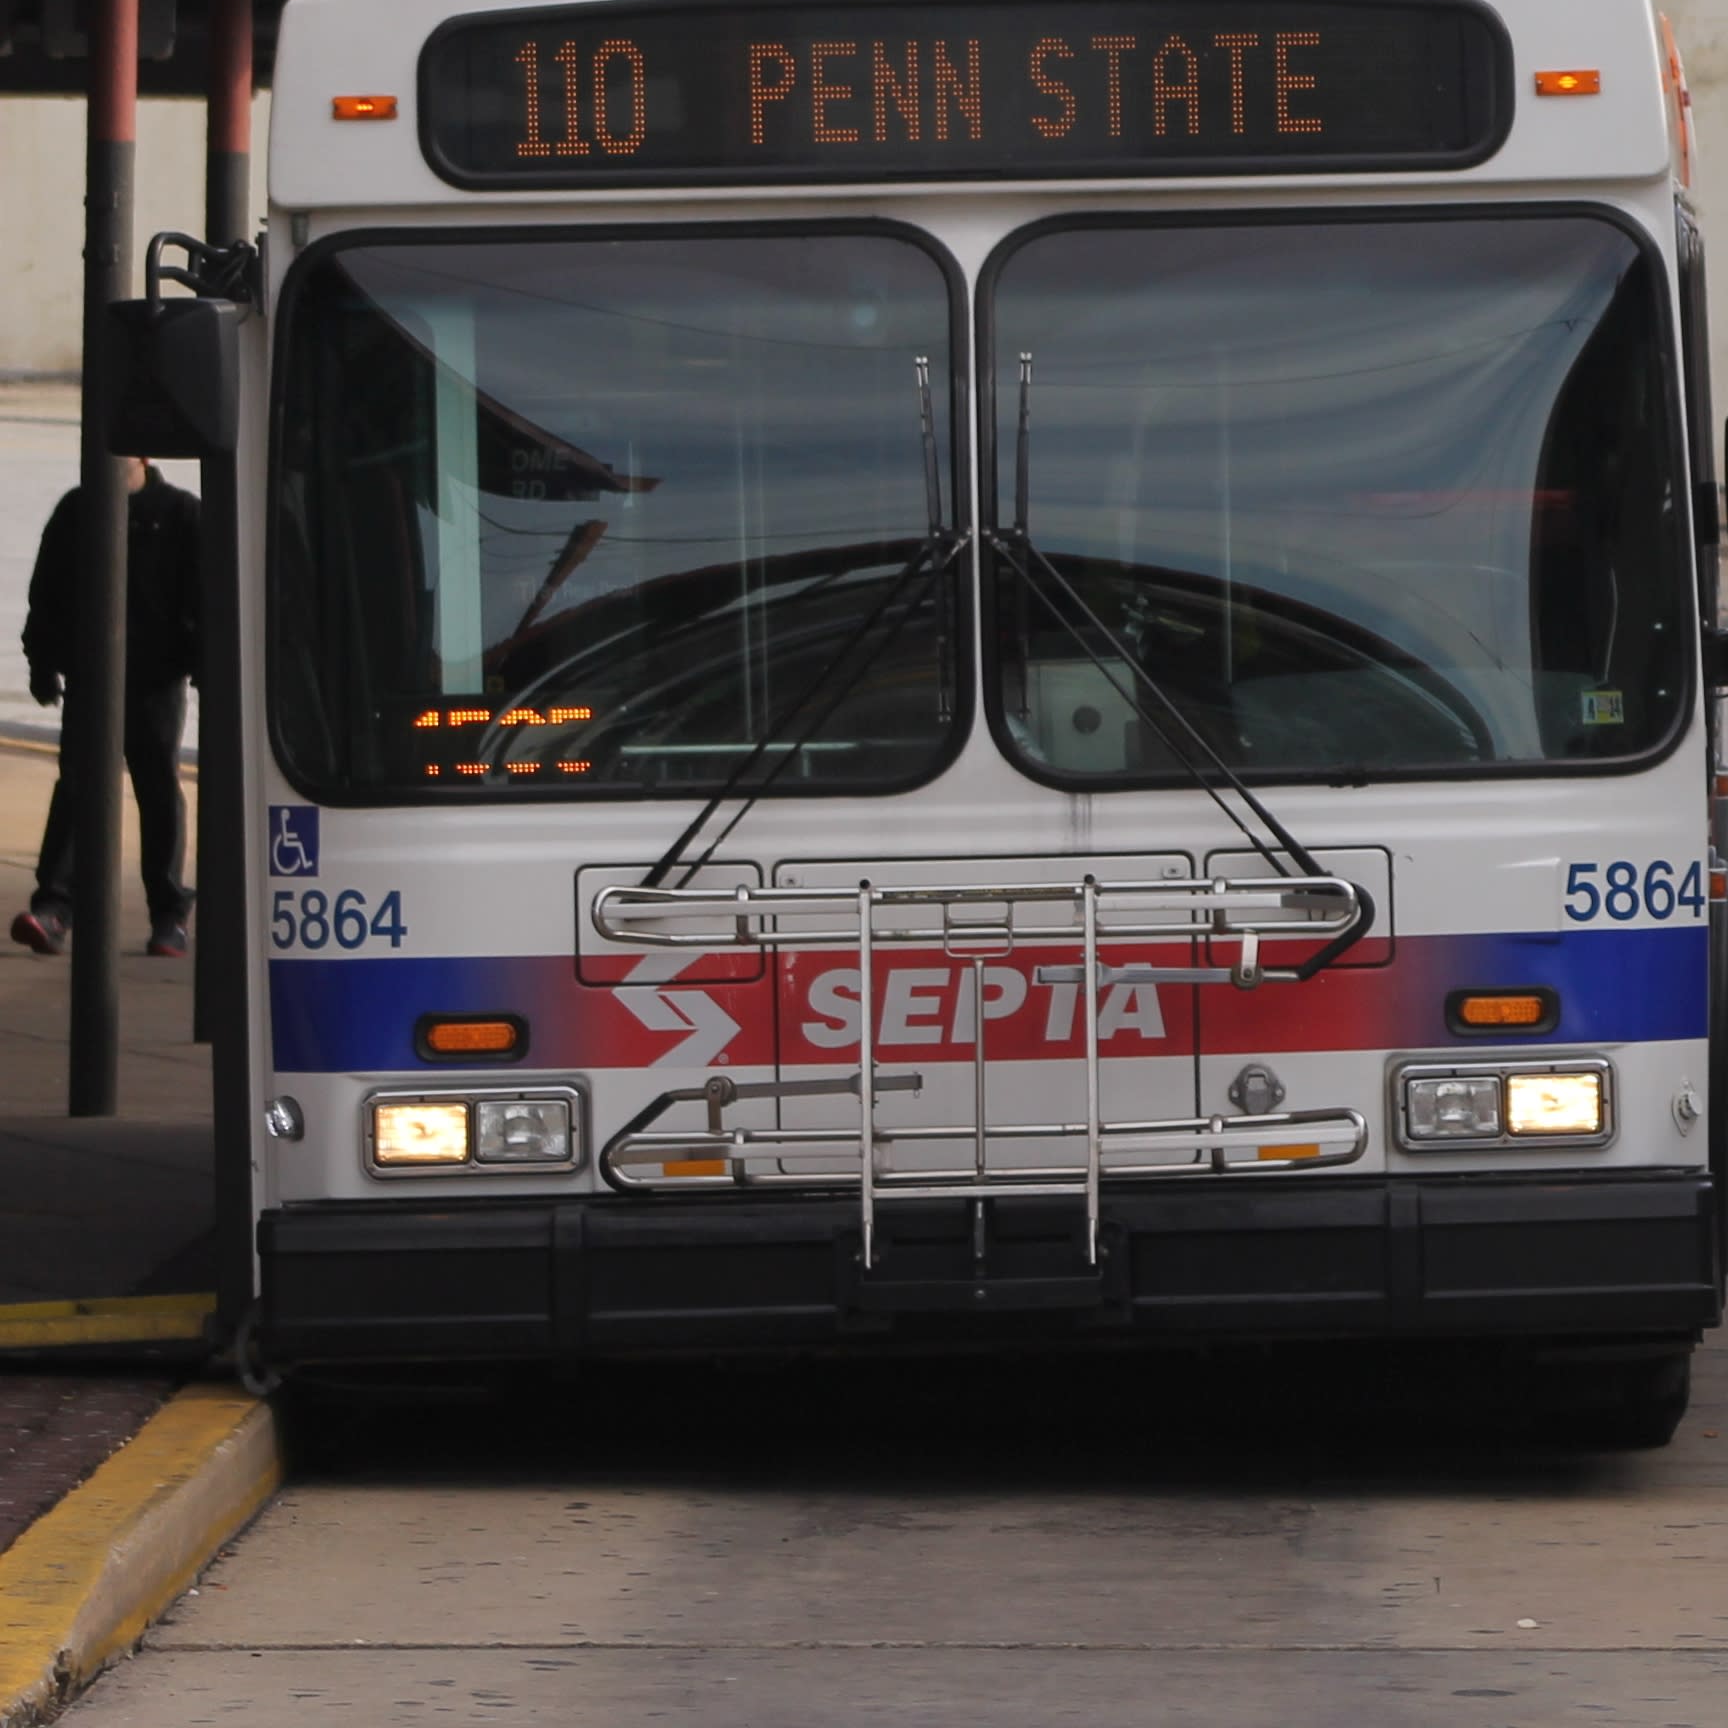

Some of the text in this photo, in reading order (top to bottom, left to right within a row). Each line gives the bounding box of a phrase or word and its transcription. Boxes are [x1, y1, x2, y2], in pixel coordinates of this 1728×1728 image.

[515, 31, 1323, 157] 110 PENN STATE
[272, 889, 407, 950] 5864
[1565, 860, 1705, 922] 5864
[802, 962, 1166, 1049] SEPTA
